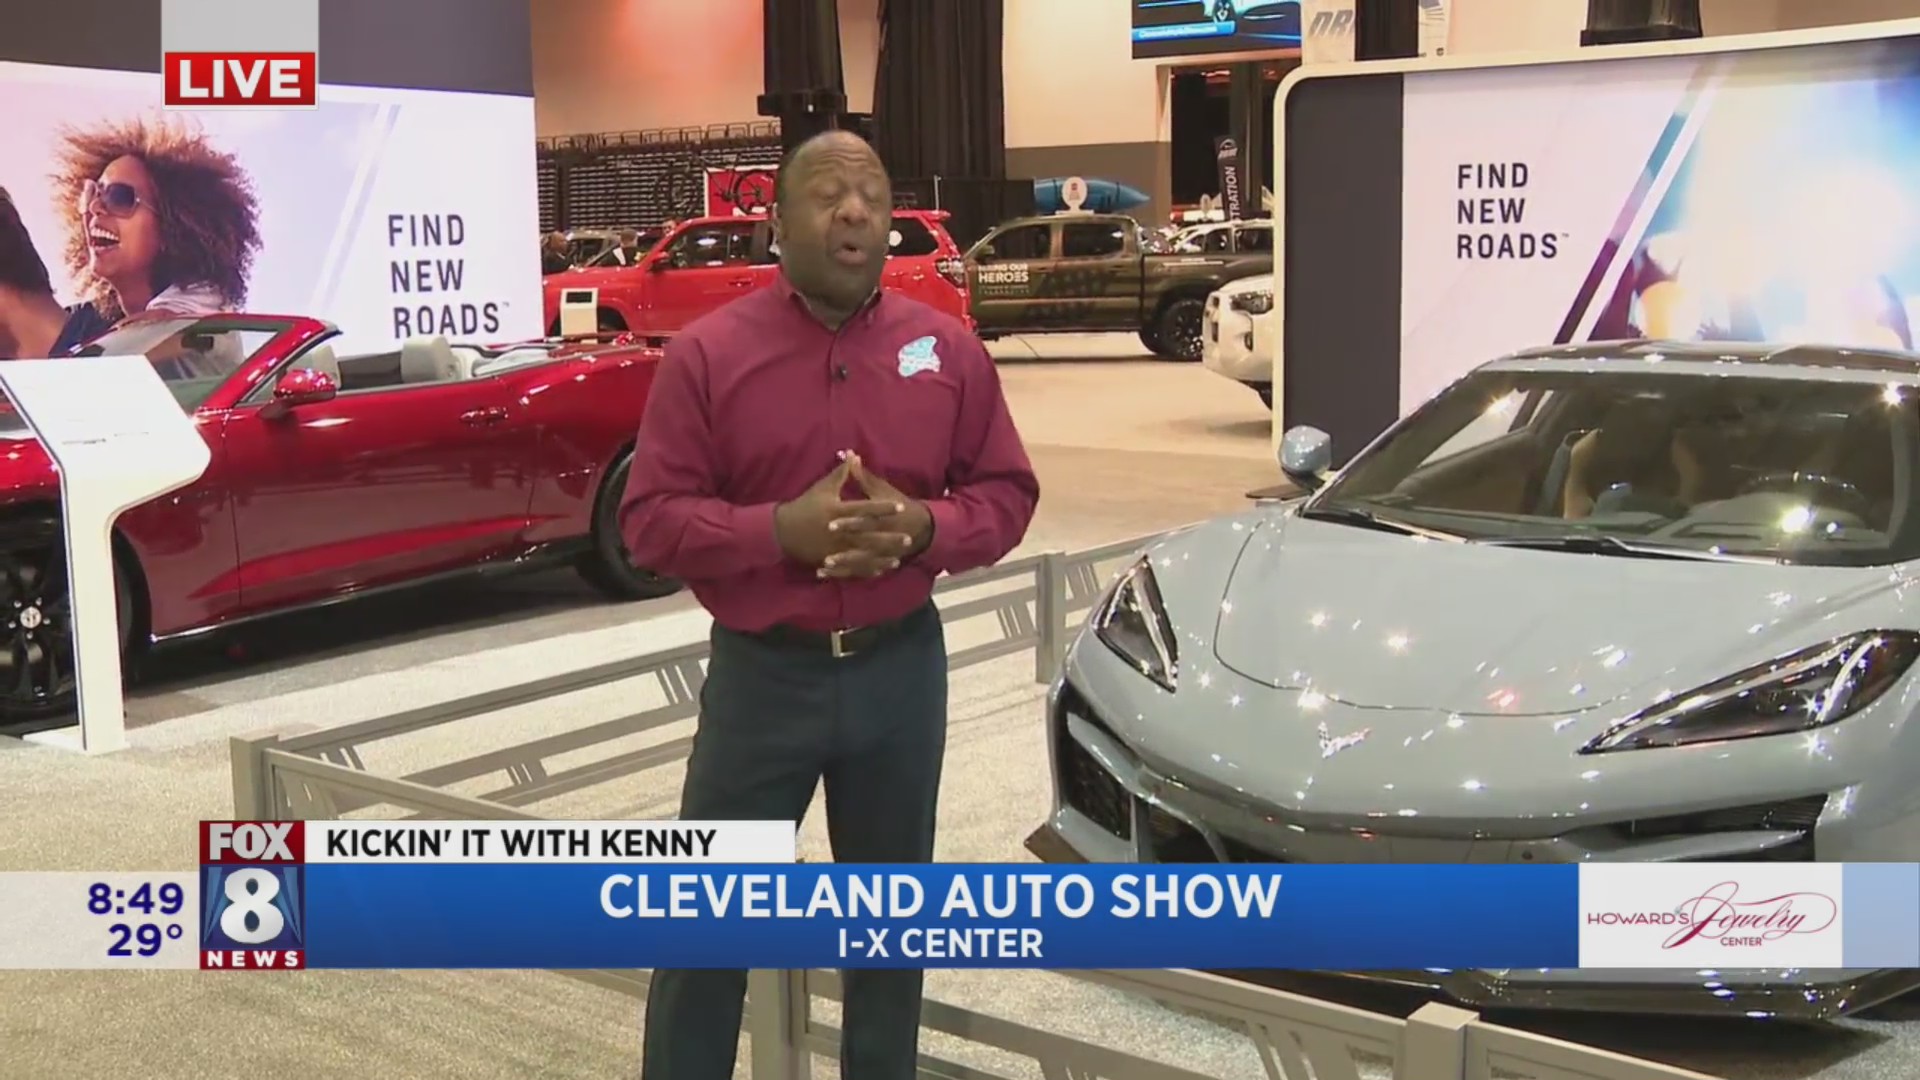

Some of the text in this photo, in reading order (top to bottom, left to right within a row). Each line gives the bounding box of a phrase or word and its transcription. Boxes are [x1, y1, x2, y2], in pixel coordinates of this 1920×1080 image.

[1457, 161, 1529, 189] FIND
[1457, 197, 1526, 225] NEW
[387, 213, 465, 247] FIND
[390, 258, 464, 294] NEW
[978, 271, 1030, 284] HEROES
